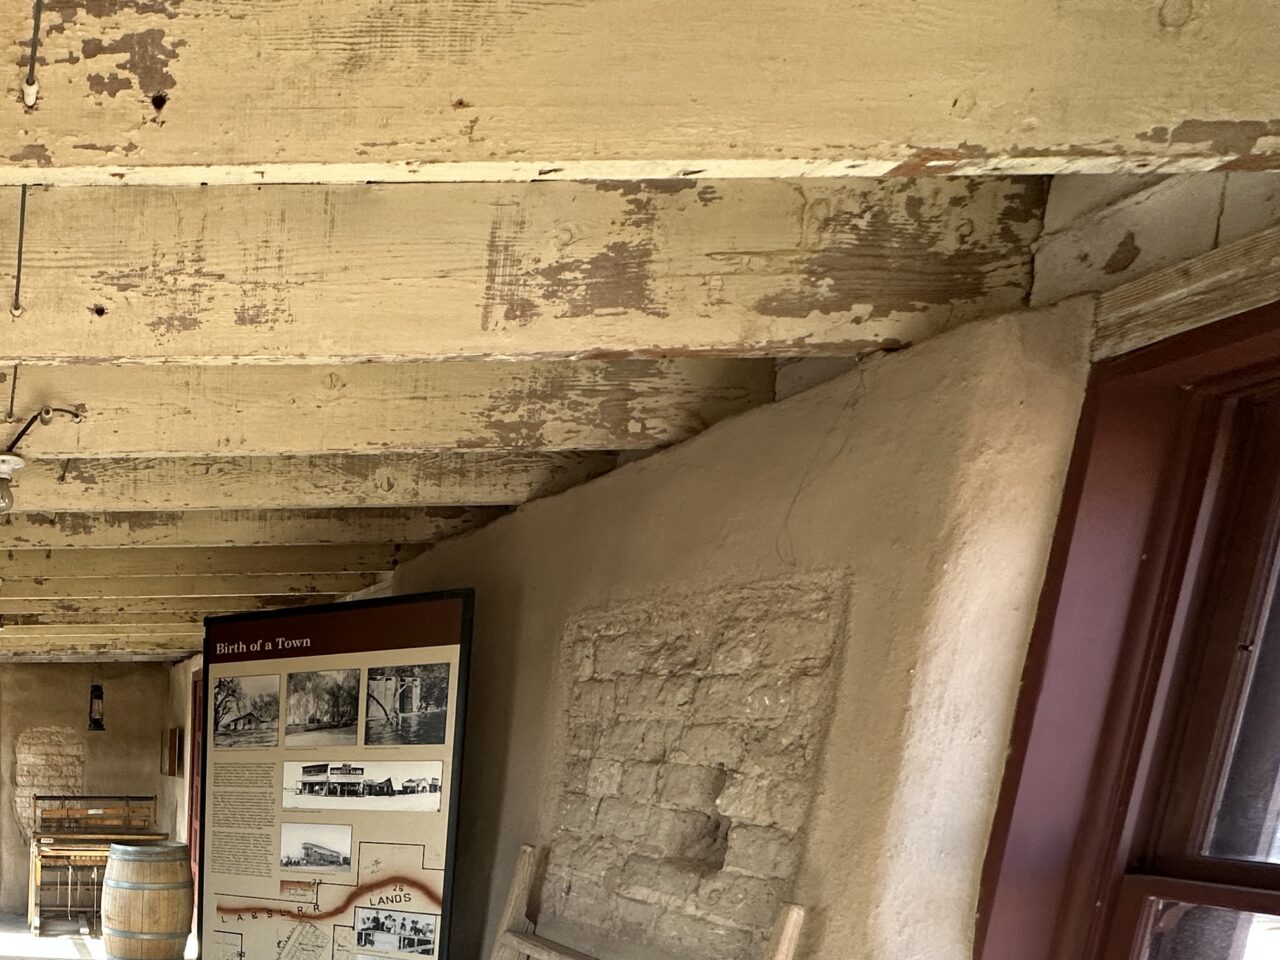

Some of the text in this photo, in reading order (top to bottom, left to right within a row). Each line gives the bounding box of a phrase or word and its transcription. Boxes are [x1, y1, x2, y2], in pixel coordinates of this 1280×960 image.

[216, 637, 311, 655] Birth of a Town
[392, 883, 404, 892] 26
[369, 892, 412, 907] LANDS
